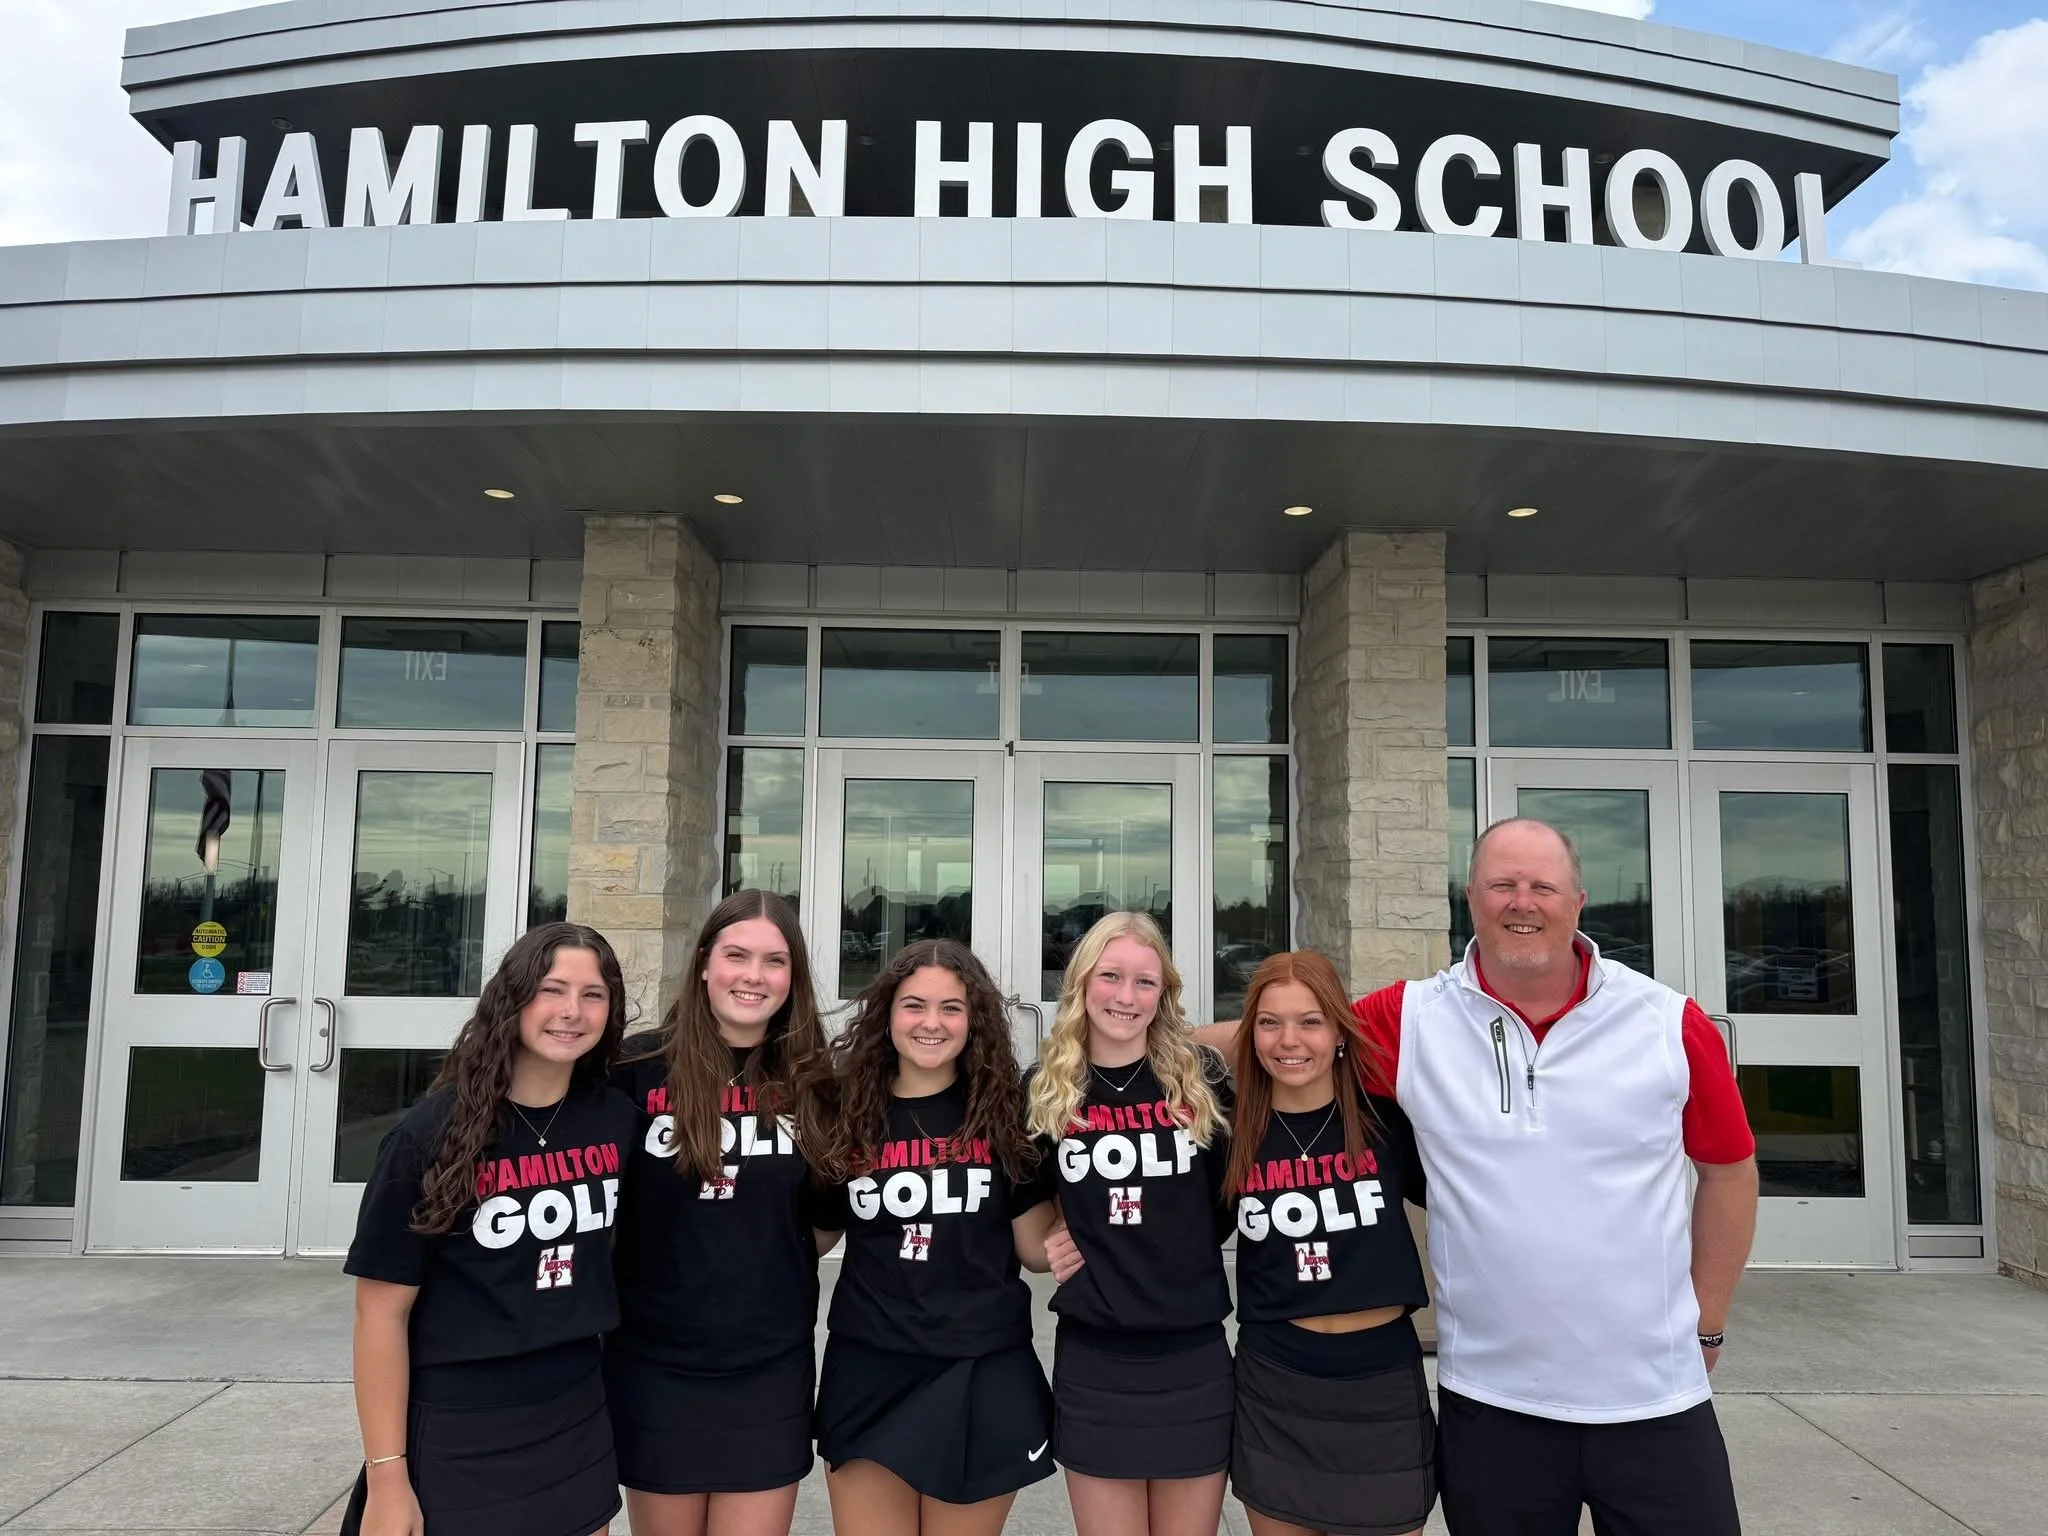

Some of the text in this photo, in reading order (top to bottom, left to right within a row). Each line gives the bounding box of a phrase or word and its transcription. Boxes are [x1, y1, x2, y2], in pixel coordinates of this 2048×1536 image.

[166, 113, 1863, 271] HAMILTON HIGH SCHOOL
[1065, 1100, 1195, 1135] AMILTO
[476, 1142, 620, 1196] HAMILTON
[1057, 1128, 1198, 1184] GOLF
[1236, 1148, 1378, 1193] AMILTON
[472, 1178, 619, 1249] GOLF
[847, 1168, 992, 1220] GOLF
[1237, 1179, 1386, 1242] GOLF
